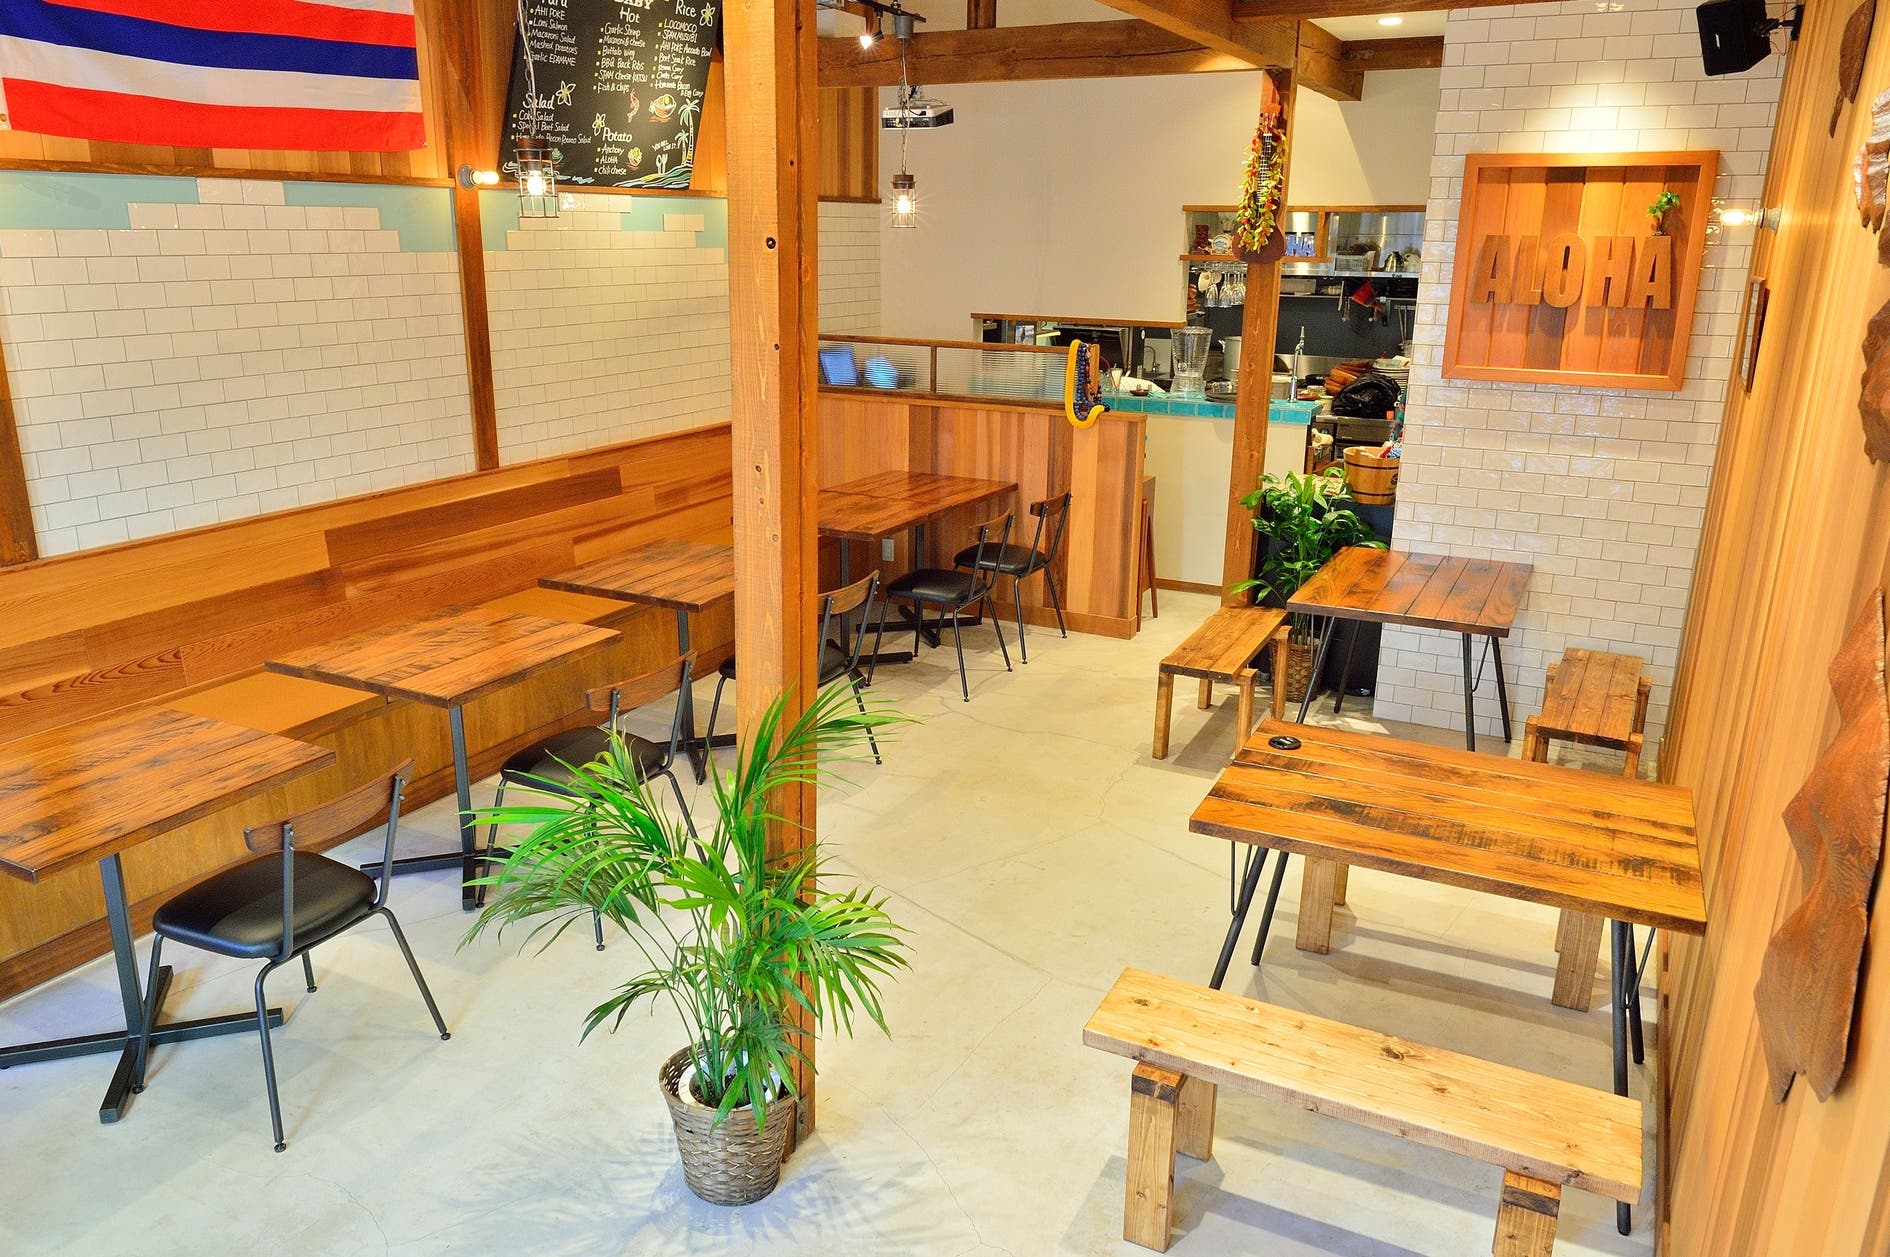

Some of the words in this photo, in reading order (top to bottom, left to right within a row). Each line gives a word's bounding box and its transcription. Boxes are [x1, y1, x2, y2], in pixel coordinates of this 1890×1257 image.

[534, 4, 549, 16] AHI
[549, 8, 566, 21] POKE
[620, 6, 640, 23] Hot
[676, 0, 697, 17] Rice
[548, 19, 568, 31] Salmon
[664, 18, 698, 33] LOCOMOCO
[531, 29, 559, 40] Macaroni
[559, 32, 576, 44] Salad
[522, 92, 555, 110] Salad
[602, 127, 632, 143] Potato
[1470, 234, 1671, 309] ALOHA
